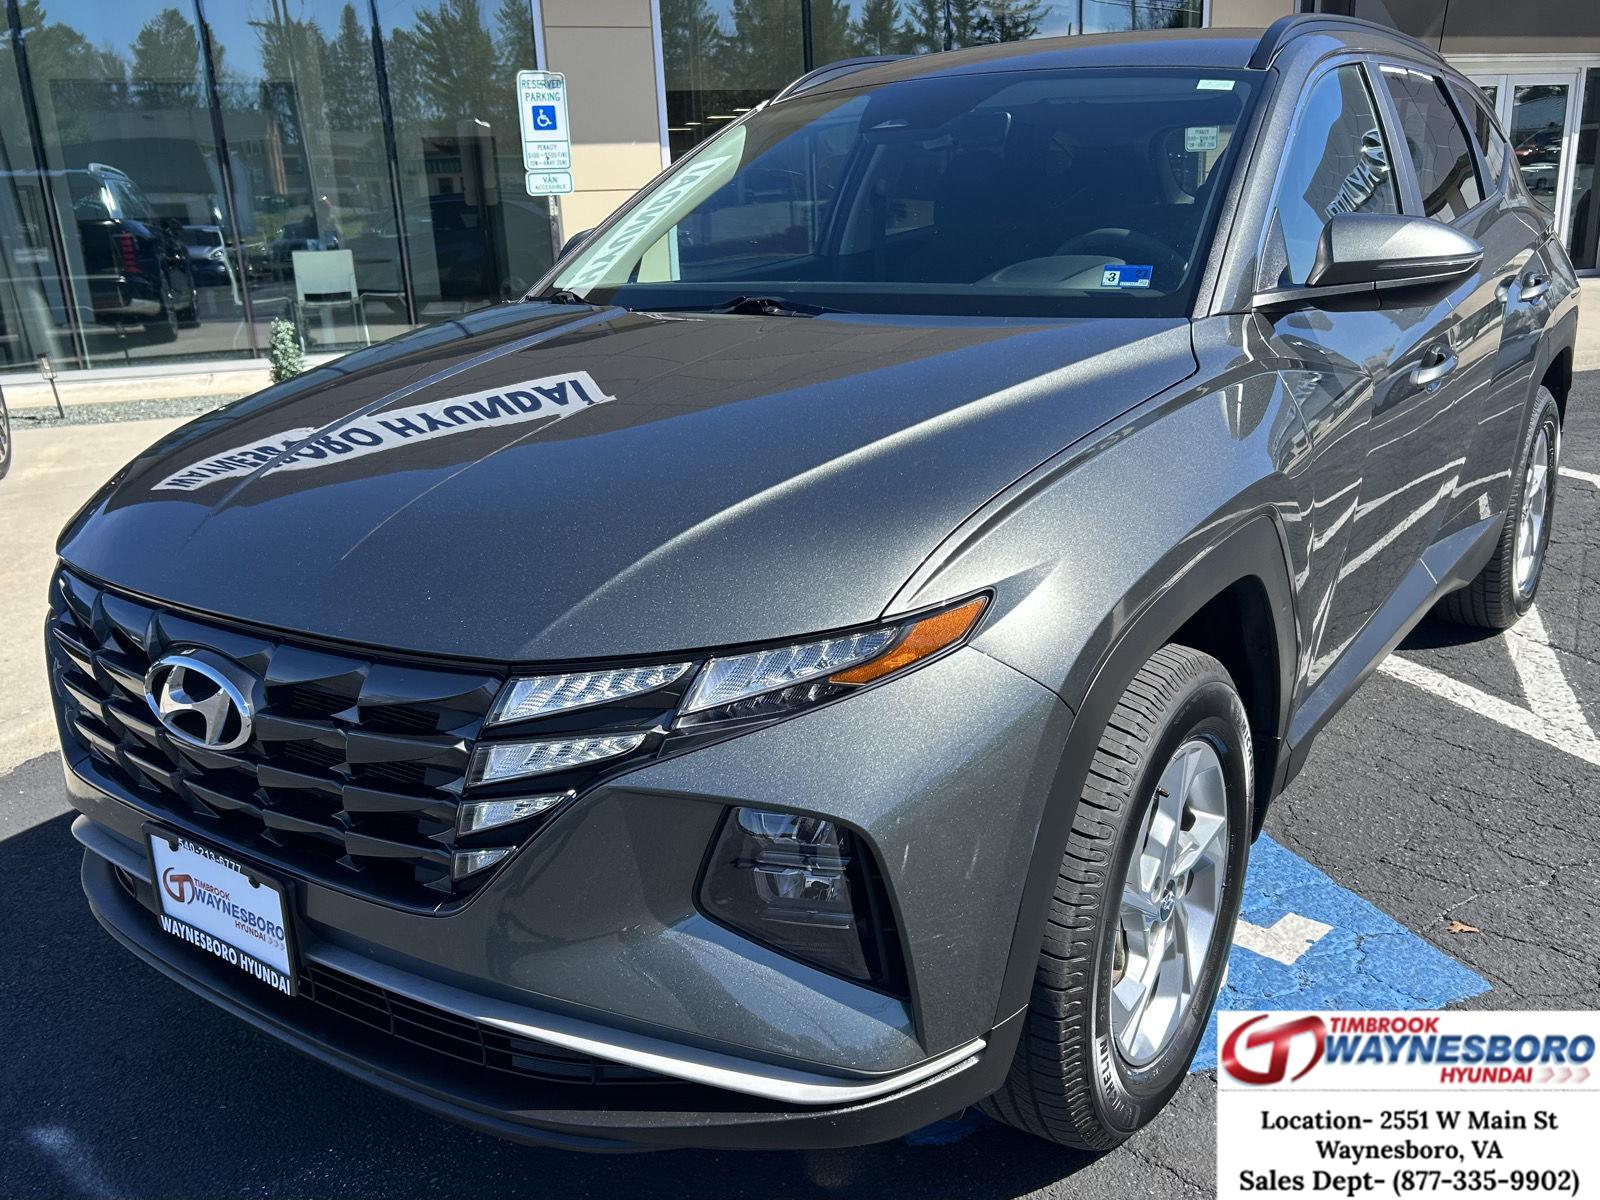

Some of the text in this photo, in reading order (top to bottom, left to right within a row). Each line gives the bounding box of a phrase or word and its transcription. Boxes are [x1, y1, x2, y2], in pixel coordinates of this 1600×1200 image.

[521, 80, 562, 89] RESERVED
[525, 92, 561, 102] PARKING
[1108, 272, 1117, 282] 3
[194, 877, 231, 901] TIMBROOK
[195, 888, 285, 941] WAYNESBORO
[234, 920, 266, 942] HYUNDAI
[160, 914, 291, 996] WAYNESBORO HYUNDAI
